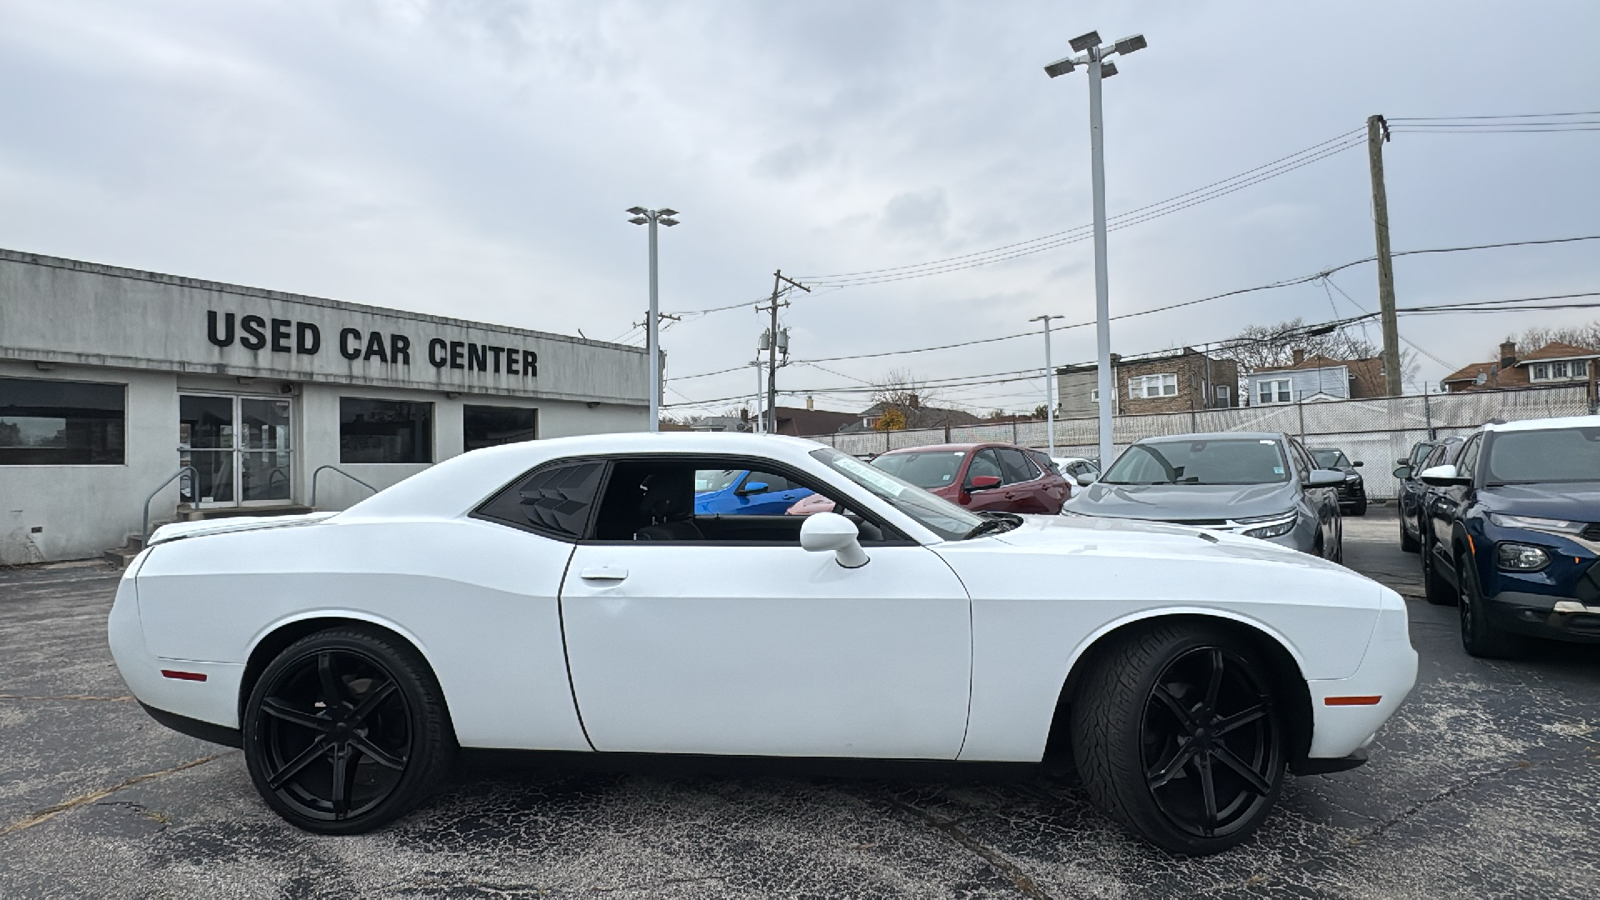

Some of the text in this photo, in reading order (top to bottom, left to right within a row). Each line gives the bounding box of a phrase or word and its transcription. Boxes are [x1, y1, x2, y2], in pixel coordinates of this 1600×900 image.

[207, 310, 538, 377] USED CAR CENTER
